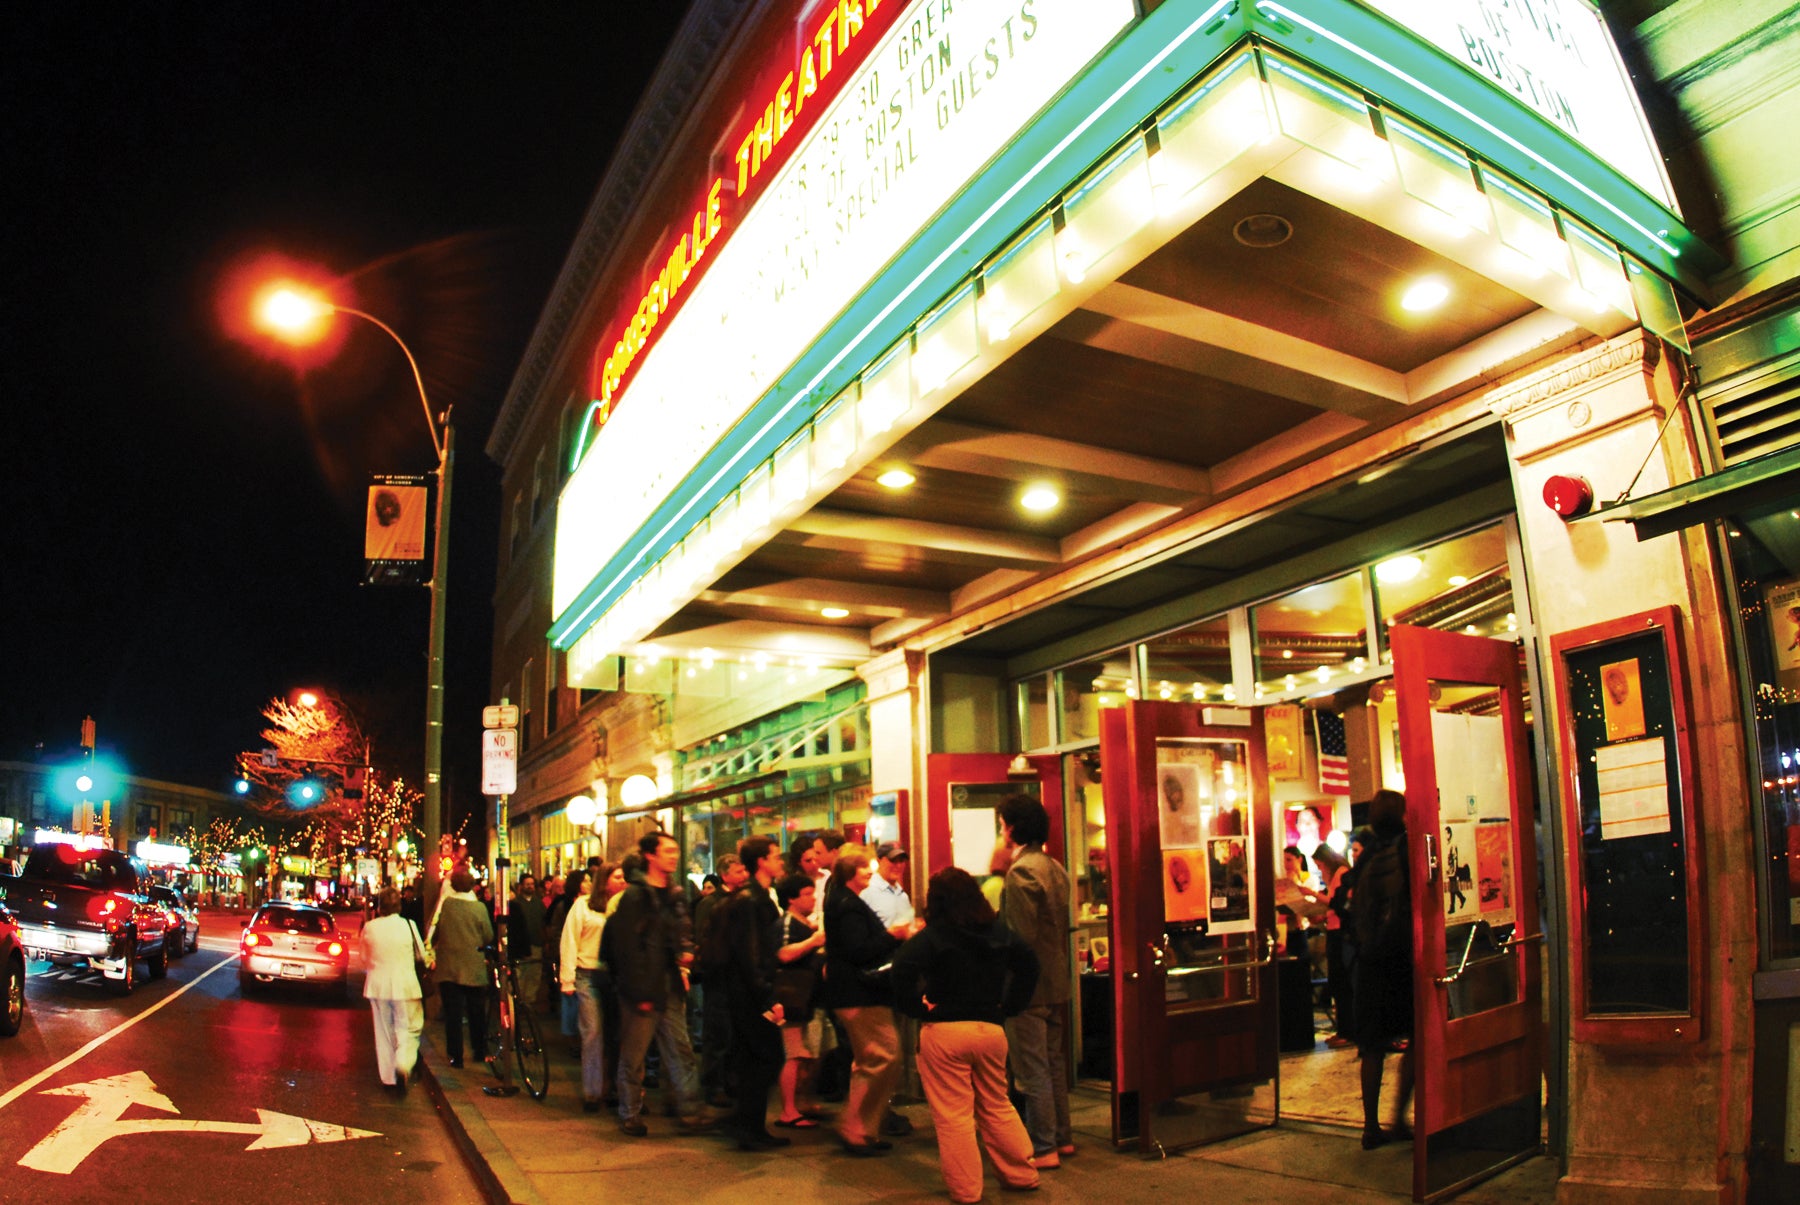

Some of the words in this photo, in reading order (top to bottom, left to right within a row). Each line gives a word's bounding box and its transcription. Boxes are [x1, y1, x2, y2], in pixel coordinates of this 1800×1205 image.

[835, 127, 919, 246] SPECIAL
[936, 0, 1038, 131] GUESTS
[865, 32, 951, 160] BOSTON
[1457, 23, 1579, 134] BOSTON
[493, 734, 506, 747] NO
